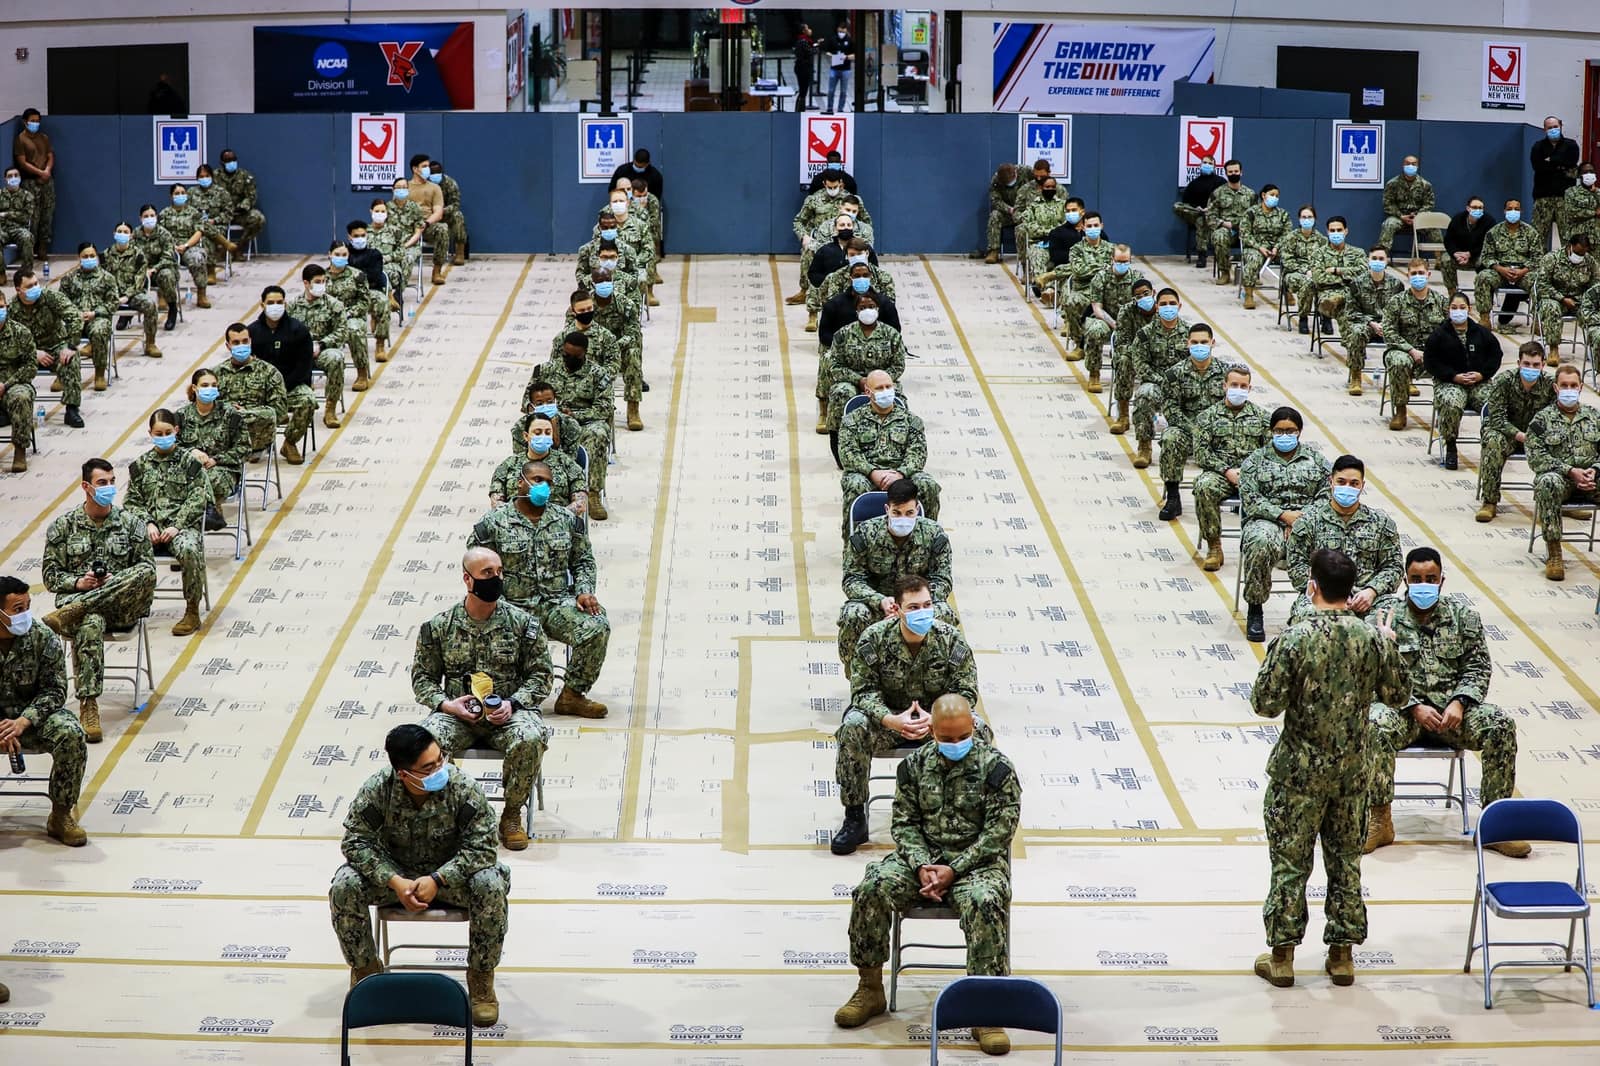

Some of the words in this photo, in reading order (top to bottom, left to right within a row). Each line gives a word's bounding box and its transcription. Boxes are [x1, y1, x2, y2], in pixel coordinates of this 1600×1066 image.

[1055, 41, 1155, 60] GAMEDAY
[316, 58, 348, 69] NCAA
[308, 79, 345, 90] Division
[347, 79, 355, 89] III
[1488, 85, 1520, 93] VACCINATE
[1048, 86, 1094, 96] EXPERIENCE
[1095, 88, 1109, 96] THE
[1111, 88, 1161, 98] DIIIFFERENCE
[359, 164, 396, 172] VACCINATE
[808, 163, 846, 172] VACCE
[1186, 167, 1225, 175] VACTE
[359, 172, 374, 180] NEW
[377, 172, 396, 180] YORK
